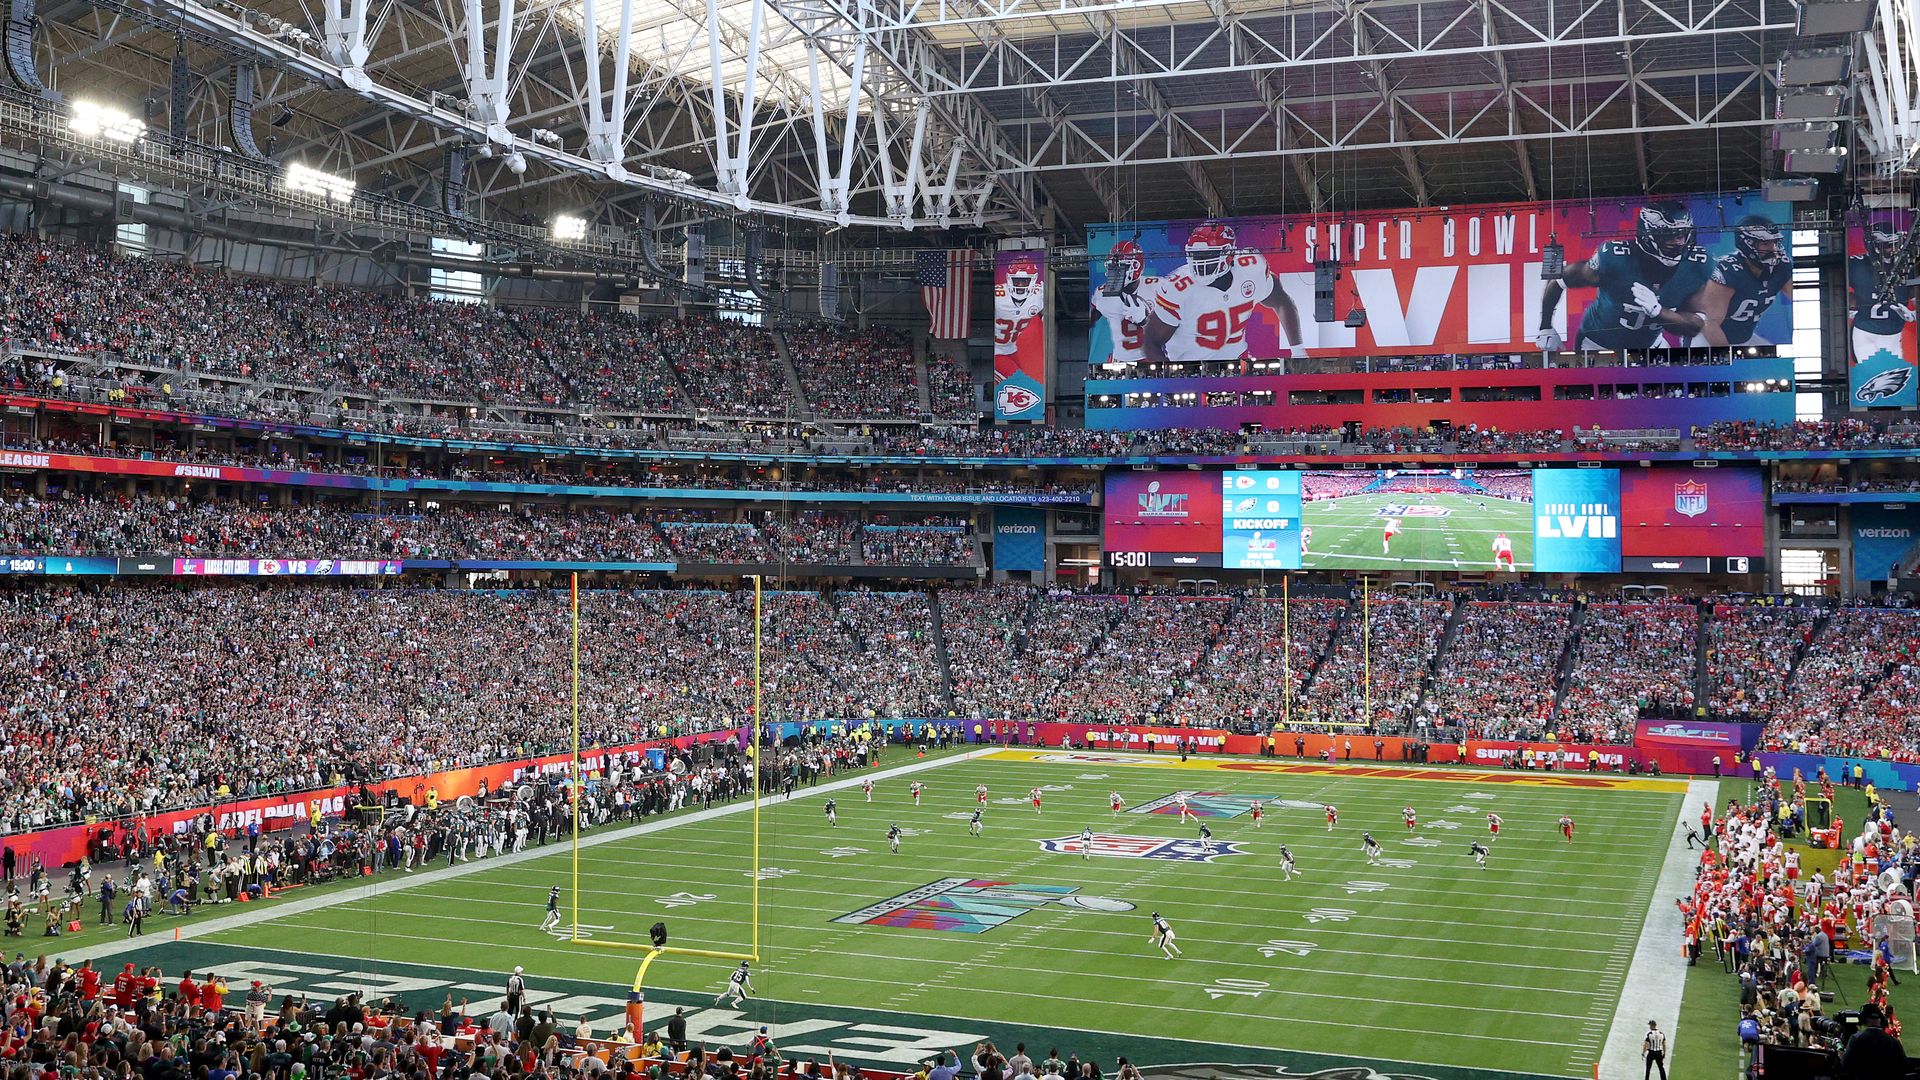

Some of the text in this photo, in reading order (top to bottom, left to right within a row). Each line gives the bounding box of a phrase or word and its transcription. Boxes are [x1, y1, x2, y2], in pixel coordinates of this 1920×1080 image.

[1305, 214, 1539, 264] SUPER BOWL
[1279, 262, 1568, 350] LVII
[1195, 300, 1256, 351] 95
[0, 454, 50, 467] LEAGUE
[175, 465, 221, 479] #SBLVII
[1545, 504, 1609, 515] SUPER BOWL
[1678, 495, 1704, 510] NFL
[997, 523, 1036, 533] verizon
[1233, 519, 1289, 530] KICKOFF
[1537, 516, 1616, 538] LVII
[1858, 526, 1910, 538] verizon
[9, 560, 36, 571] 15:00
[1110, 552, 1146, 567] 15:00
[1173, 556, 1198, 564] verizon
[1652, 561, 1680, 569] verizon
[287, 560, 307, 574] VS
[1257, 939, 1319, 957] 20
[1204, 978, 1271, 998] 10
